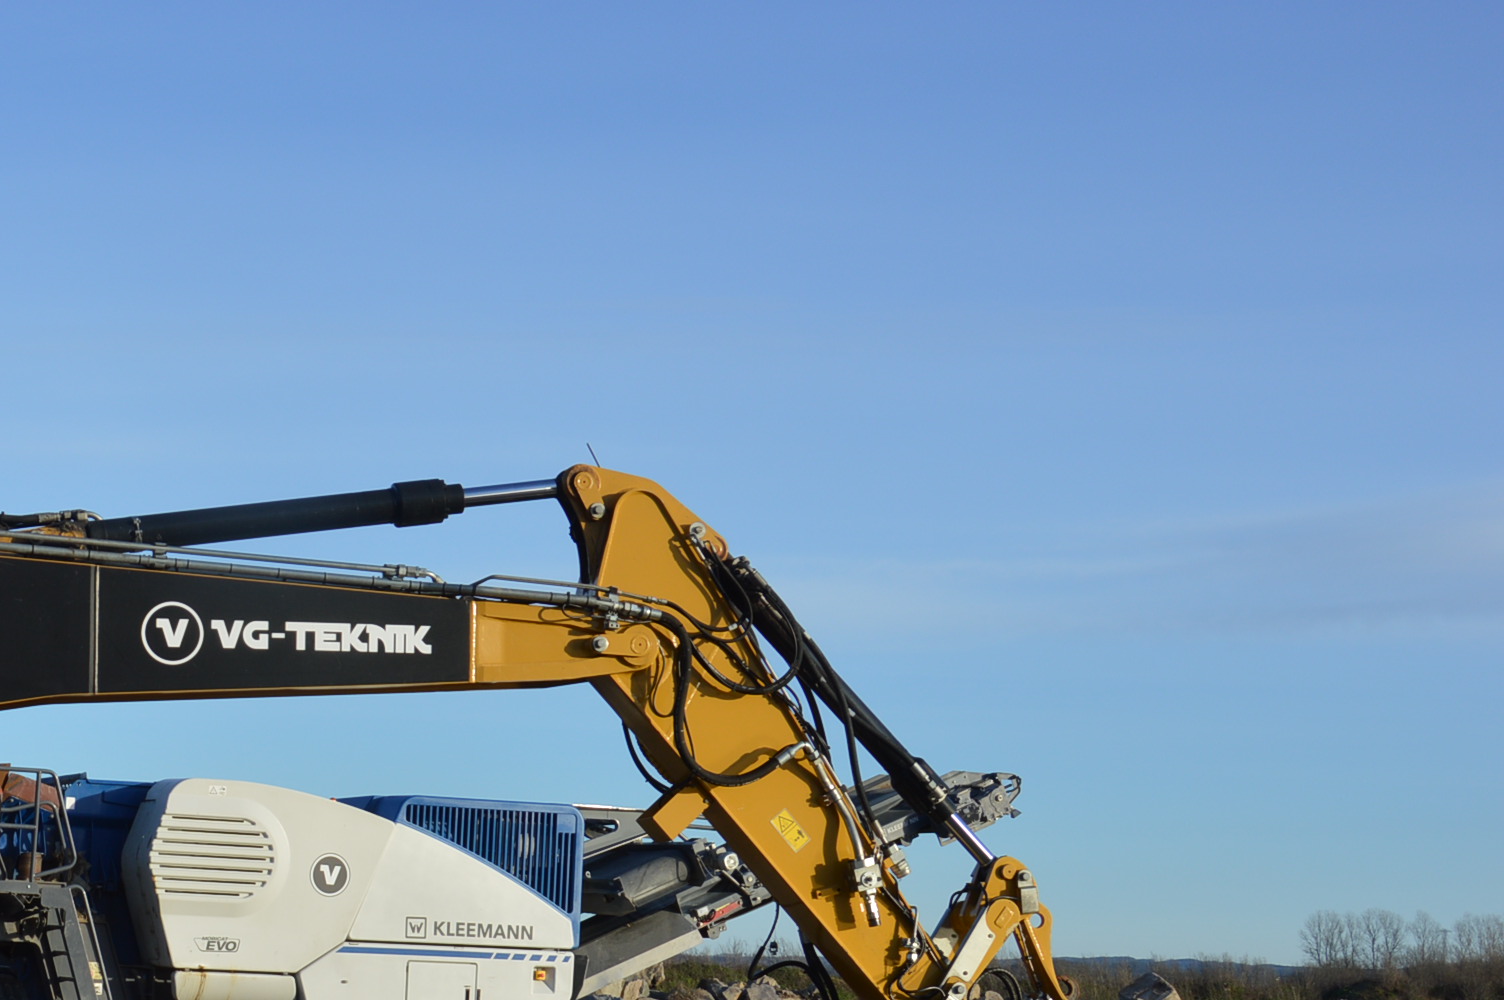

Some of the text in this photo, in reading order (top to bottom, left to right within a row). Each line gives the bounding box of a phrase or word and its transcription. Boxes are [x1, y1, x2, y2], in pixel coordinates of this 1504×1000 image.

[211, 619, 432, 654] VG-TEKNIK
[433, 920, 534, 940] KLEEMANN
[206, 940, 237, 951] EVO
